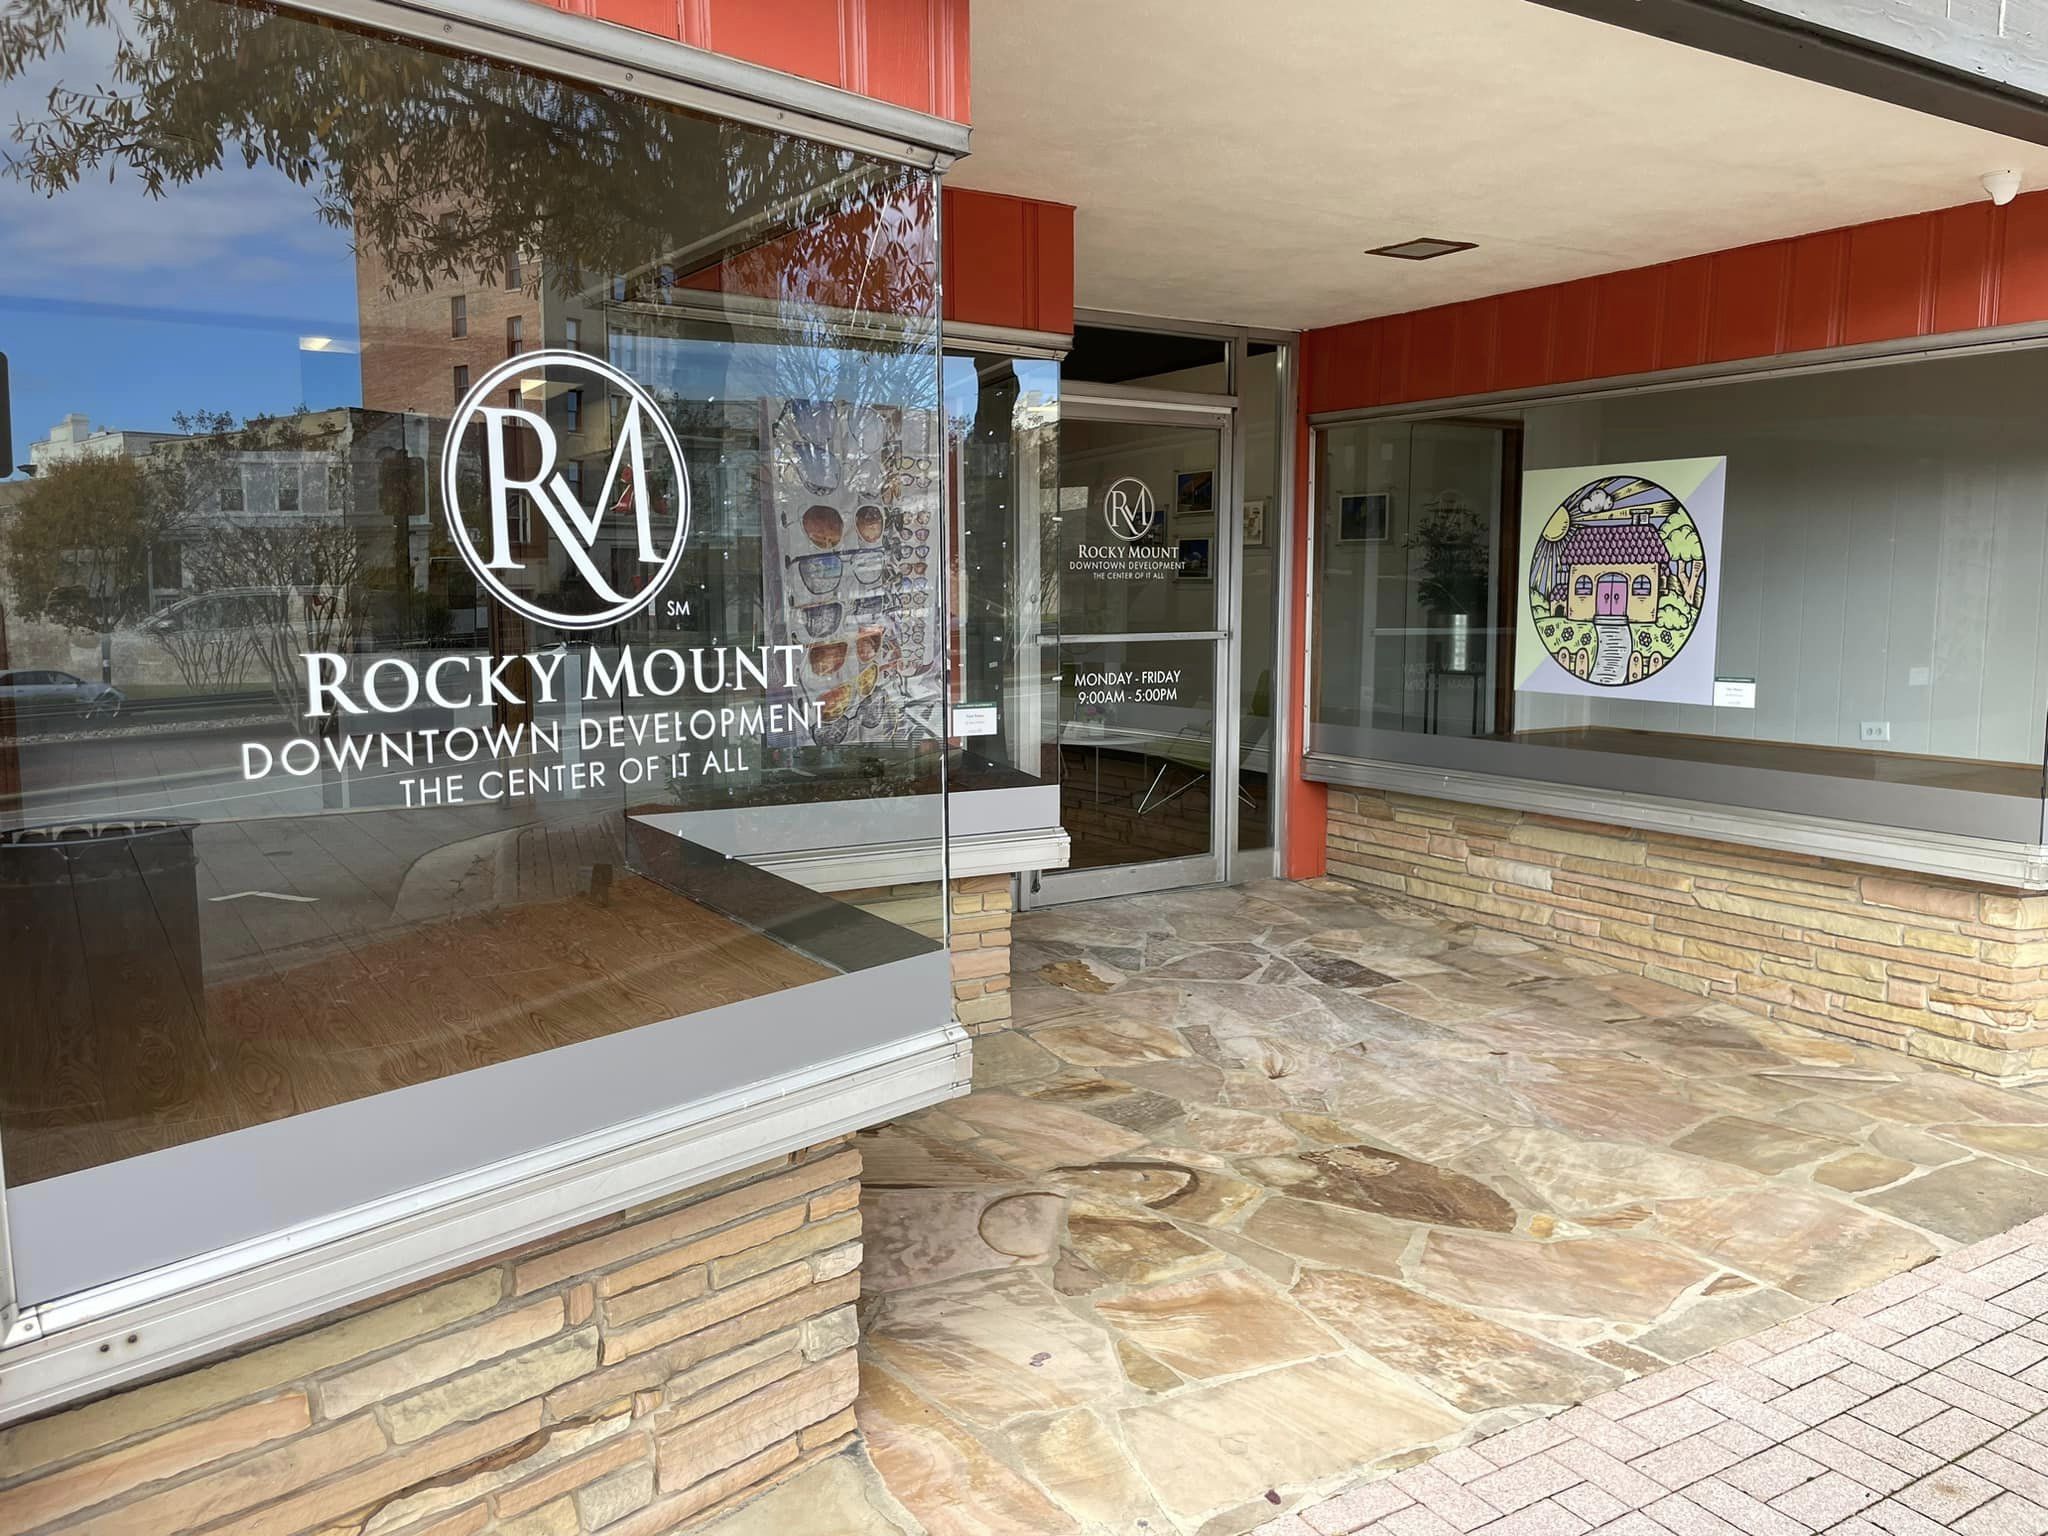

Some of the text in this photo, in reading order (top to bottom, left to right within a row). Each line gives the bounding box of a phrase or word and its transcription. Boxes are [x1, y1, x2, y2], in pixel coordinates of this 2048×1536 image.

[1078, 544, 1179, 559] ROCKY MOUNT
[1069, 561, 1186, 571] DOWNTOWN DEVELOPMENT
[1093, 572, 1165, 580] THE CENTER OF IT ALL
[666, 600, 690, 616] SM
[299, 644, 804, 718] ROCKY MOUNT
[1074, 671, 1133, 687] MONDAY
[1141, 670, 1181, 684] FRIDAY
[1078, 690, 1125, 705] 9:00AM
[1134, 688, 1178, 702] 5:00PM
[242, 701, 826, 780] DOWNTOWN DEVELOPMENT
[400, 747, 749, 808] THE CENTER OF IT ALL
